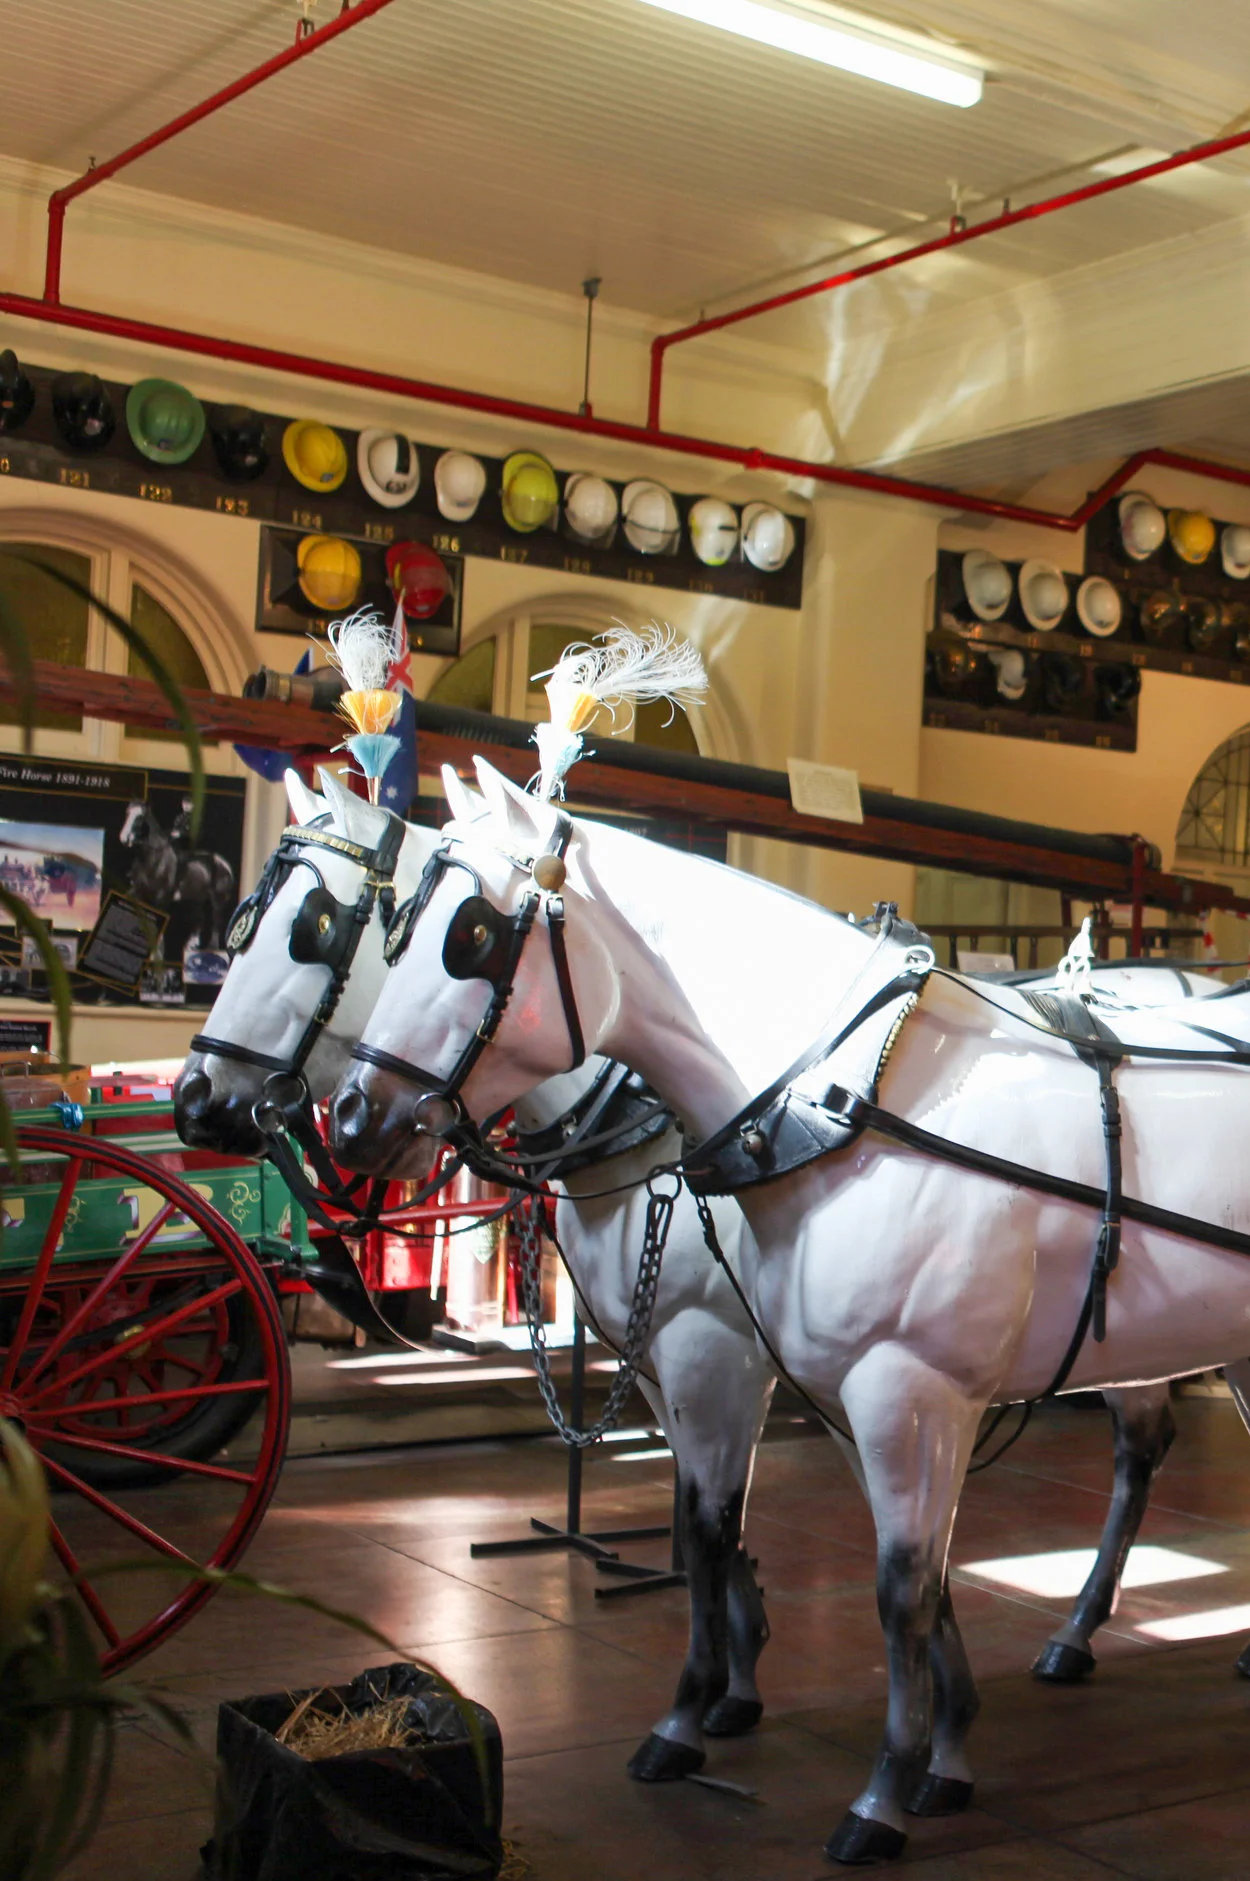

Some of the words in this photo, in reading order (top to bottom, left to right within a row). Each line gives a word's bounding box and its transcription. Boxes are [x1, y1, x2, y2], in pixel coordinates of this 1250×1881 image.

[432, 534, 460, 553] 126
[21, 767, 53, 783] Horse
[55, 772, 111, 789] 1891-1918
